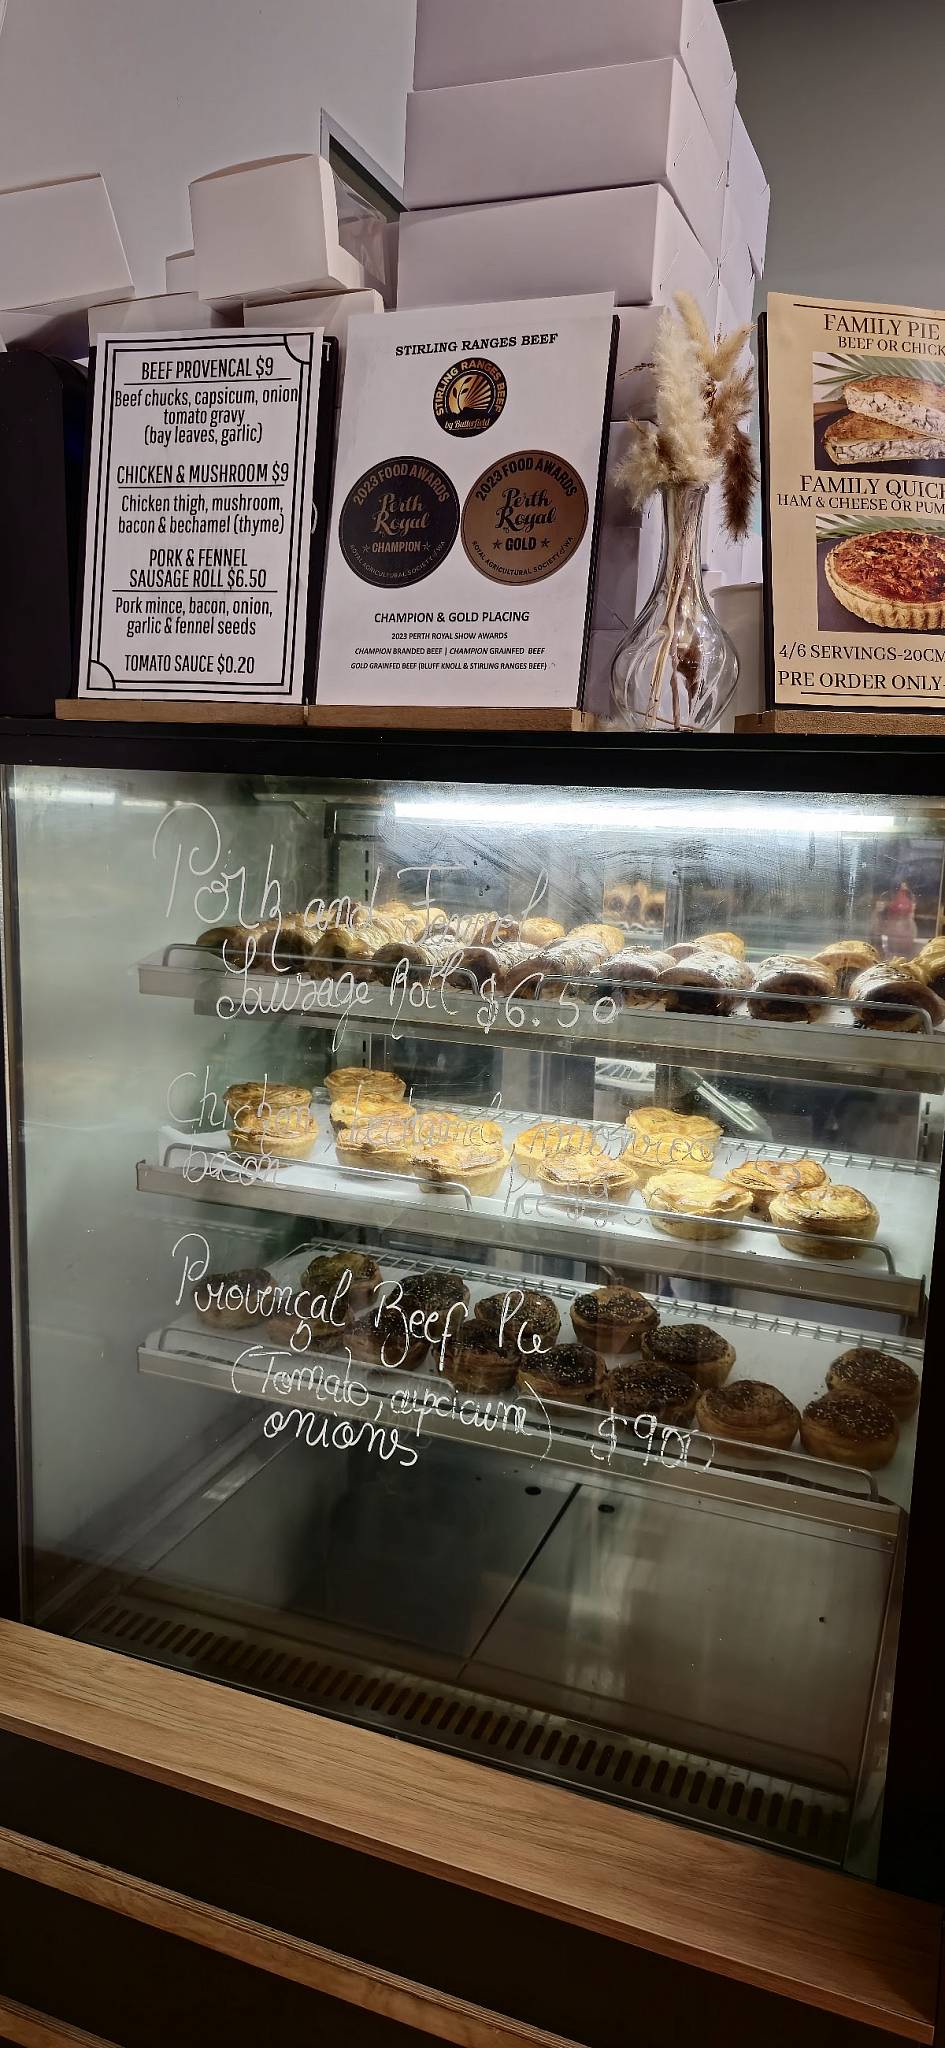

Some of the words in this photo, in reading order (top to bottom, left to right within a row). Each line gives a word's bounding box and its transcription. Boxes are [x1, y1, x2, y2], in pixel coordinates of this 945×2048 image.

[823, 313, 902, 336] FAMILY
[906, 320, 940, 340] PIE
[395, 341, 458, 356] STIRLING
[461, 337, 516, 351] RANGES
[521, 333, 559, 346] BEEF
[838, 336, 875, 350] BEEF
[877, 338, 899, 351] OR
[141, 361, 173, 380] BEEF
[176, 358, 252, 379] PROVENCAL
[256, 356, 274, 379] $9
[115, 390, 142, 407] Beef
[144, 388, 191, 407] chucks,
[194, 387, 258, 408] capsicum,
[262, 385, 298, 404] onion
[434, 367, 458, 416] STIRLING
[461, 359, 501, 381] RANGES
[495, 382, 506, 413] BEEF
[163, 408, 207, 425] tomato
[210, 408, 246, 428] gravy
[444, 421, 454, 430] by
[144, 427, 172, 448] (bay
[175, 426, 218, 445] leaves,
[220, 422, 263, 446] garlic)
[117, 464, 173, 484] CHICKEN
[176, 466, 185, 483] &
[189, 463, 268, 483] MUSHROOM
[271, 461, 289, 485] $9
[475, 472, 503, 501] 2023
[502, 457, 534, 477] FOOD
[535, 459, 577, 497] AWARDS
[353, 475, 379, 506] 2023
[378, 463, 408, 482] FOOD
[409, 464, 450, 502] AWARDS
[799, 474, 881, 495] FAMILY
[121, 494, 170, 512] Chicken
[173, 494, 208, 516] thigh,
[211, 494, 284, 513] mushroom,
[379, 493, 423, 513] Perth
[502, 488, 551, 508] Perth
[777, 493, 812, 507] HAM
[815, 495, 825, 507] &
[828, 497, 888, 511] CHEESE
[890, 500, 912, 512] OR
[118, 516, 154, 534] bacon
[158, 517, 166, 533] &
[170, 515, 230, 534] bechamel
[233, 514, 284, 536] (thyme)
[371, 511, 430, 537] Royal
[495, 507, 556, 533] Royal
[372, 541, 421, 553] CHAMPION
[505, 537, 537, 551] GOLD
[149, 548, 182, 567] PORK
[186, 550, 194, 566] &
[198, 548, 248, 567] FENNEL
[533, 551, 560, 572] SOCIETY
[129, 568, 189, 588] SAUSAGE
[193, 569, 224, 588] ROLL
[227, 566, 267, 590] $6.50
[115, 596, 142, 614] Pork
[145, 597, 186, 616] mince,
[189, 597, 229, 617] bacon,
[232, 597, 273, 617] onion,
[374, 612, 434, 624] CHAMPION
[436, 612, 445, 623] &
[448, 611, 479, 623] GOLD
[482, 611, 530, 623] PLACING
[126, 617, 161, 638] garlic
[164, 617, 173, 634] &
[176, 616, 214, 634] fennel
[217, 618, 256, 636] seeds
[391, 631, 408, 640] 2023
[408, 631, 430, 640] PERTH
[431, 631, 453, 640] ROYAL
[454, 631, 476, 640] SHOW
[477, 631, 508, 640] AWARDS
[354, 647, 392, 655] CHAMPION
[392, 647, 425, 655] BRANDED
[426, 647, 443, 655] BEEF
[449, 647, 488, 655] CHAMPION
[489, 647, 525, 655] GRAINFED
[528, 647, 545, 655] BEEF
[778, 642, 807, 659] 4/6
[125, 654, 171, 672] TOMATO
[174, 655, 214, 673] SAUCE
[217, 656, 255, 675] $0.20
[350, 662, 368, 670] GOLD
[369, 662, 400, 670] GRAINFED
[401, 662, 417, 670] BEEF
[440, 662, 462, 670] KNOLL
[462, 662, 468, 670] &
[470, 662, 499, 670] STIRLING
[500, 662, 526, 670] RANGES
[528, 662, 548, 670] BEEF)
[778, 670, 815, 687] PRE
[819, 672, 887, 690] ORDER
[153, 802, 294, 973] Pork
[303, 865, 382, 930] and
[216, 934, 373, 1053] Sausage
[389, 950, 465, 1040] Roll
[476, 972, 620, 1034] $6.50
[182, 1127, 281, 1187] bacon
[374, 1280, 468, 1372] Beef
[262, 1407, 419, 1468] onions
